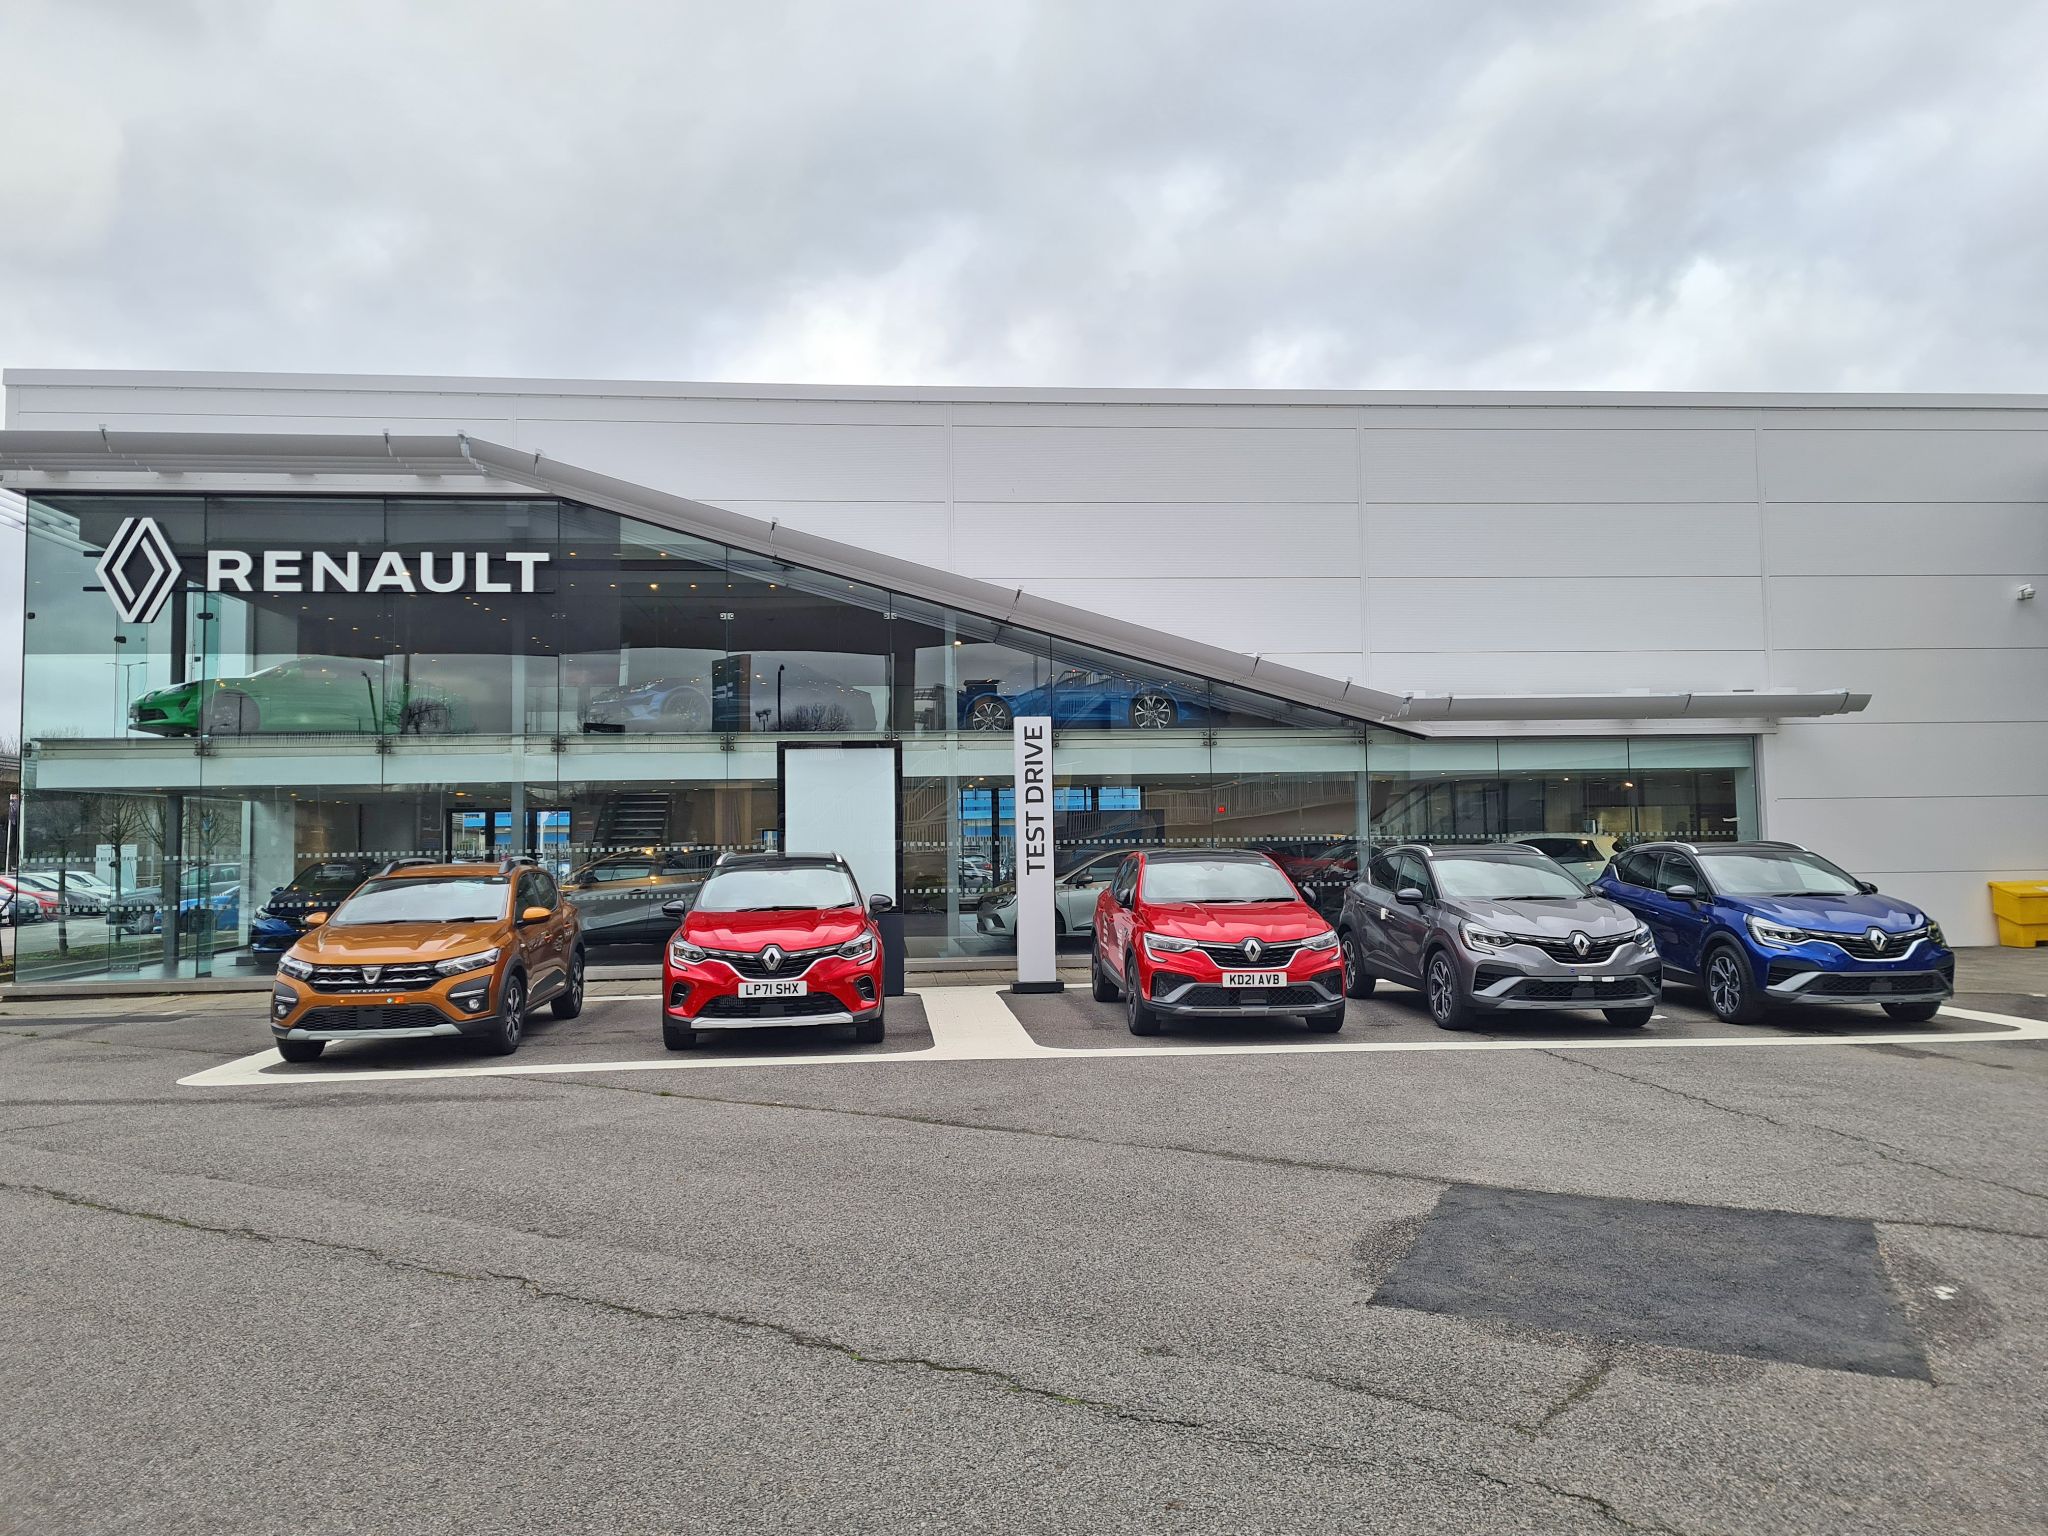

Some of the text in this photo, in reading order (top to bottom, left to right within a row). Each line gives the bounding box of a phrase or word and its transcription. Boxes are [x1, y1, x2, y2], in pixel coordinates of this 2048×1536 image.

[207, 550, 550, 593] RENAULT
[1024, 725, 1045, 875] TEST DRIVE
[745, 983, 799, 996] LP71 SHX
[1229, 974, 1280, 985] KD21 AVB
